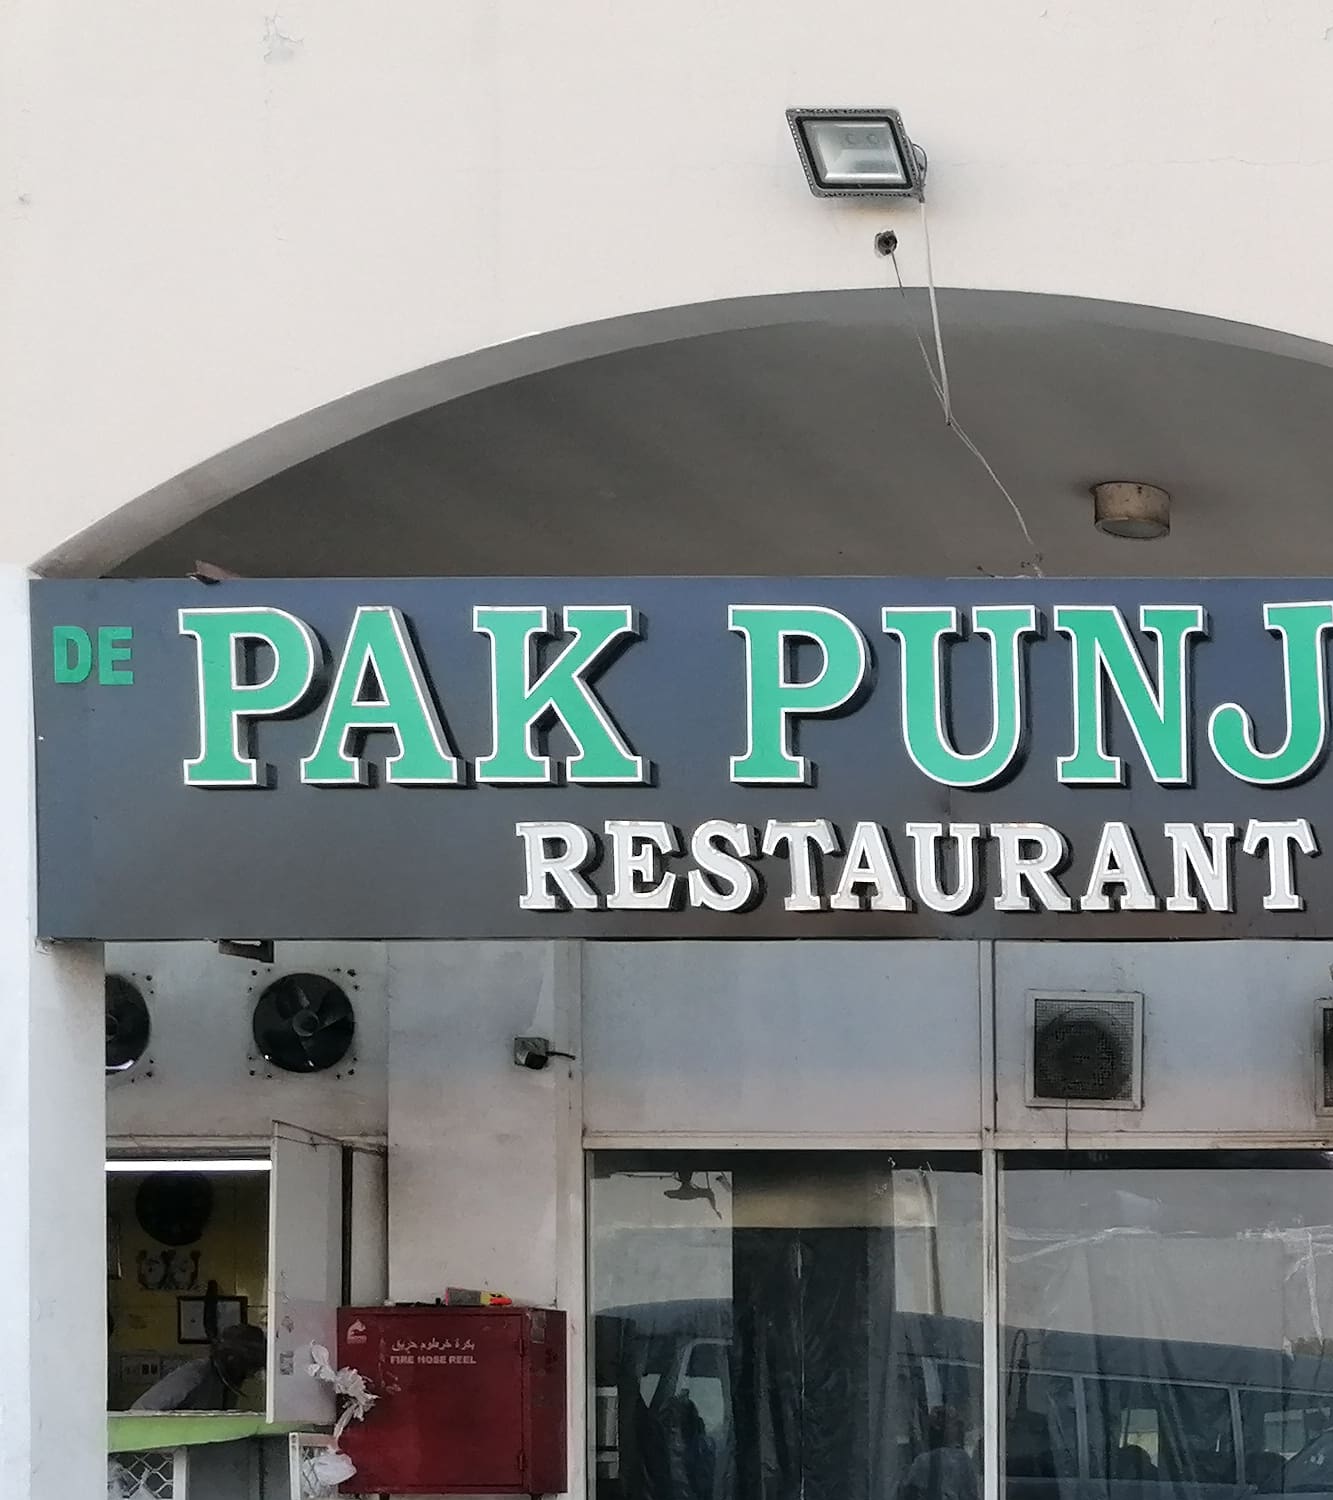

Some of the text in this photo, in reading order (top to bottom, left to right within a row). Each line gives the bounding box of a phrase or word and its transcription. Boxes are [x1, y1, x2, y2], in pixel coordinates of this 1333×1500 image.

[52, 624, 135, 687] DE
[178, 604, 650, 787] PAK
[515, 818, 1318, 913] RESTAURANT
[390, 1355, 476, 1365] FIRE HOSE REEL
